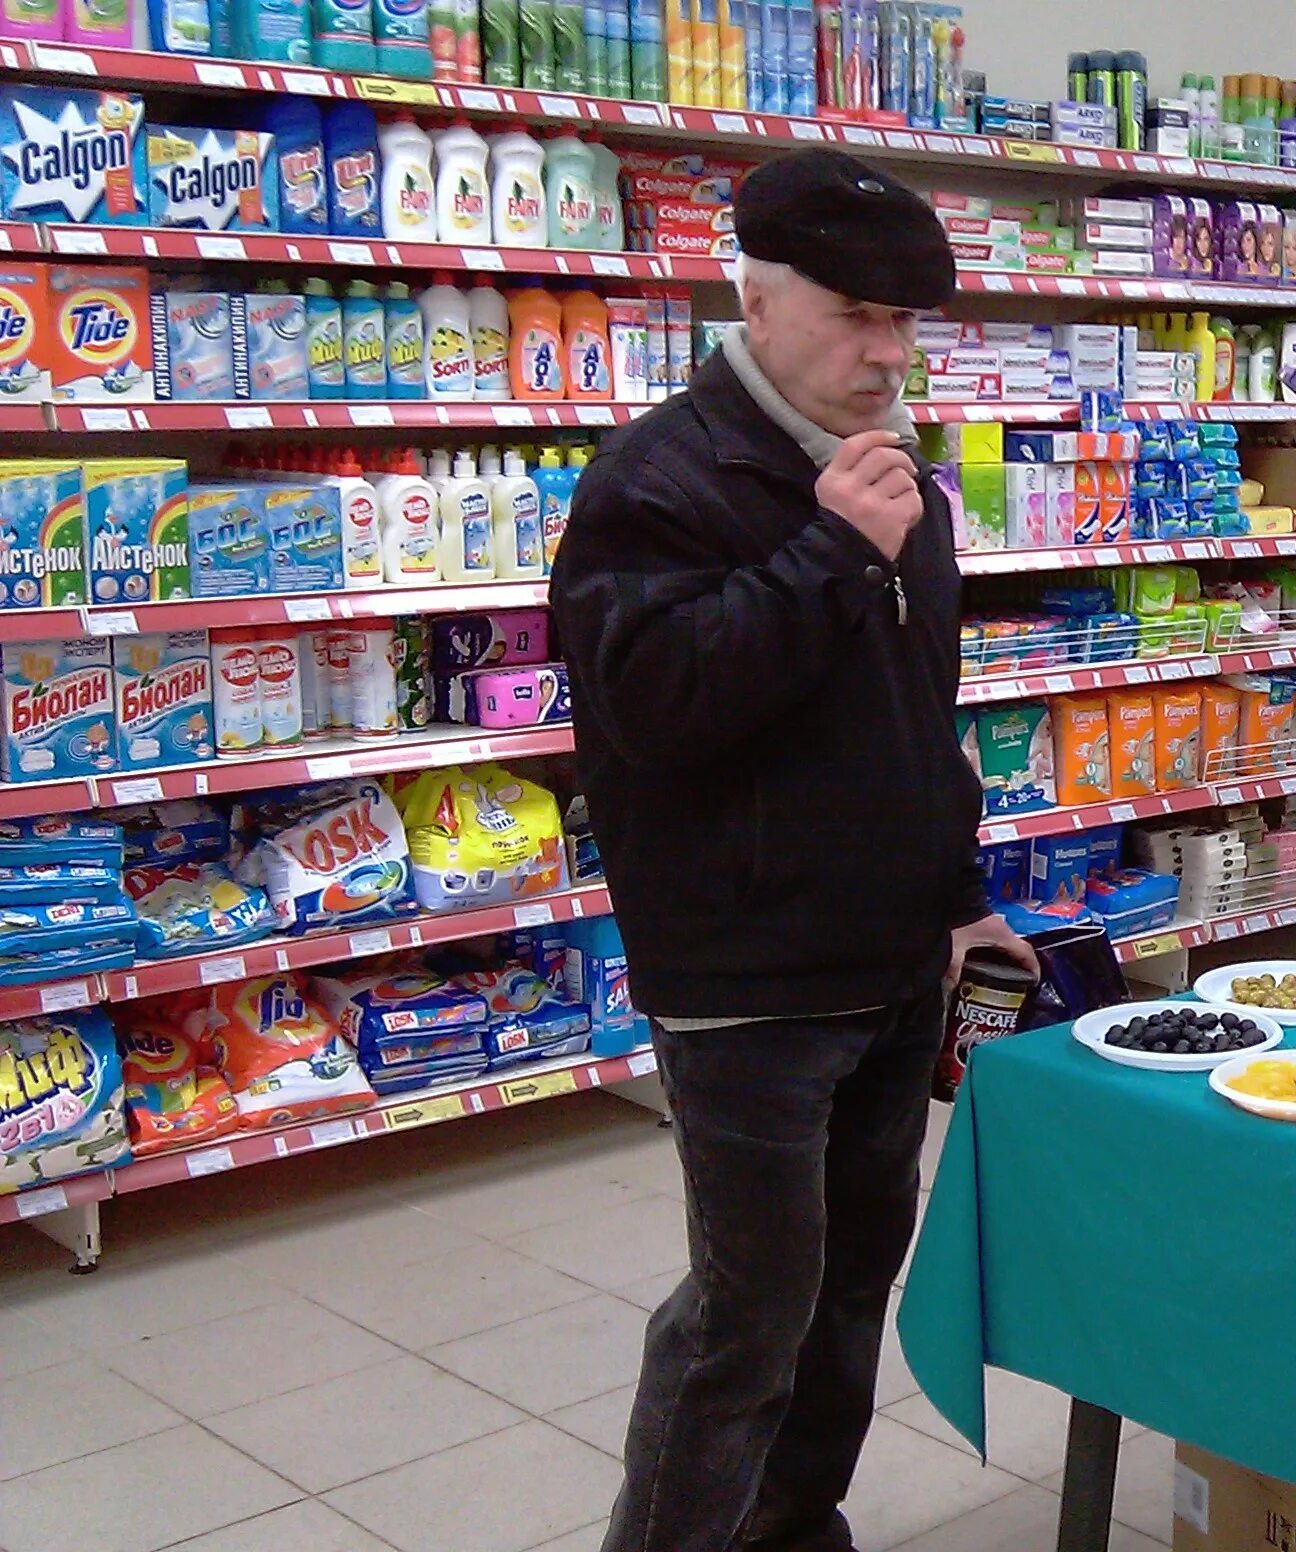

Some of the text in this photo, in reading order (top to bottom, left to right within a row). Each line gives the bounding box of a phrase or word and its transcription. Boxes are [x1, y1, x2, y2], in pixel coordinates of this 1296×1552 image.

[20, 130, 127, 190] Calgon
[169, 156, 257, 204] Calgon
[658, 205, 713, 222] Colgate
[657, 233, 712, 250] Colgate
[0, 307, 26, 338] de
[70, 303, 130, 350] Tide
[153, 295, 172, 398] АНТИНАКИПИН
[232, 296, 250, 398] АНТИНАКИПИН
[533, 342, 552, 389] AOS
[583, 342, 602, 389] AOS
[0, 541, 82, 578] истенок
[12, 673, 108, 734] Биолан
[122, 663, 207, 723] Биолан
[387, 1013, 417, 1031] LOSK
[500, 1031, 528, 1049] LOSK
